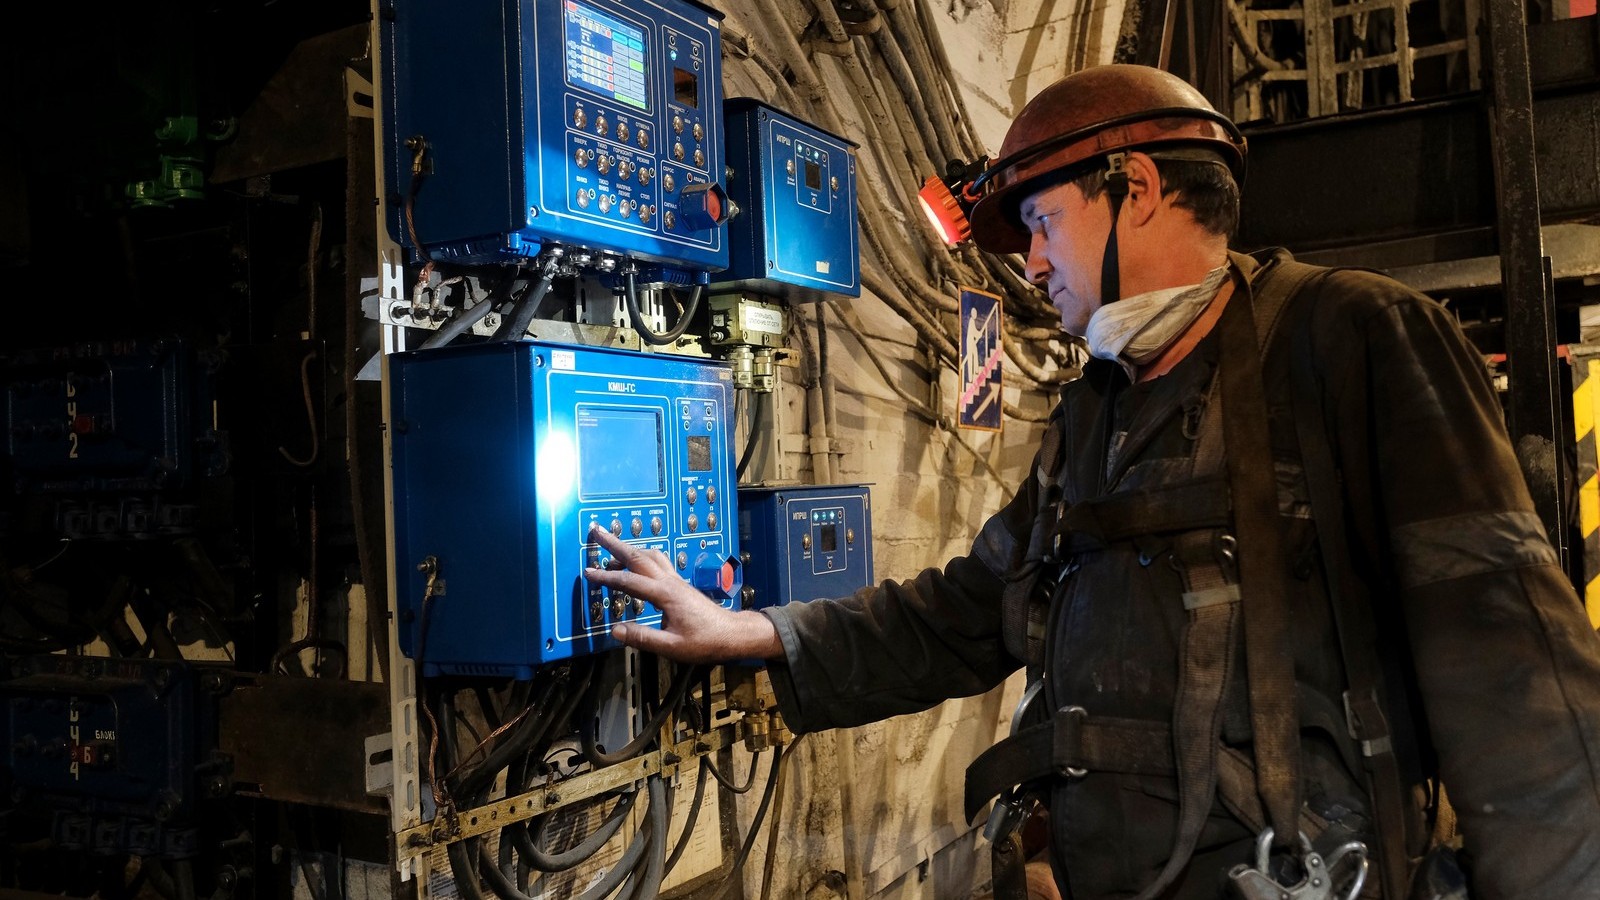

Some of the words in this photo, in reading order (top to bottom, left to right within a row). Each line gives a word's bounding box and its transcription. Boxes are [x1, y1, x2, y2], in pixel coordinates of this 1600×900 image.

[574, 137, 588, 146] ВВЕРХ
[776, 134, 791, 147] ИПРШ
[608, 382, 636, 393] КМШ-ГС
[793, 512, 806, 520] ИПРШ
